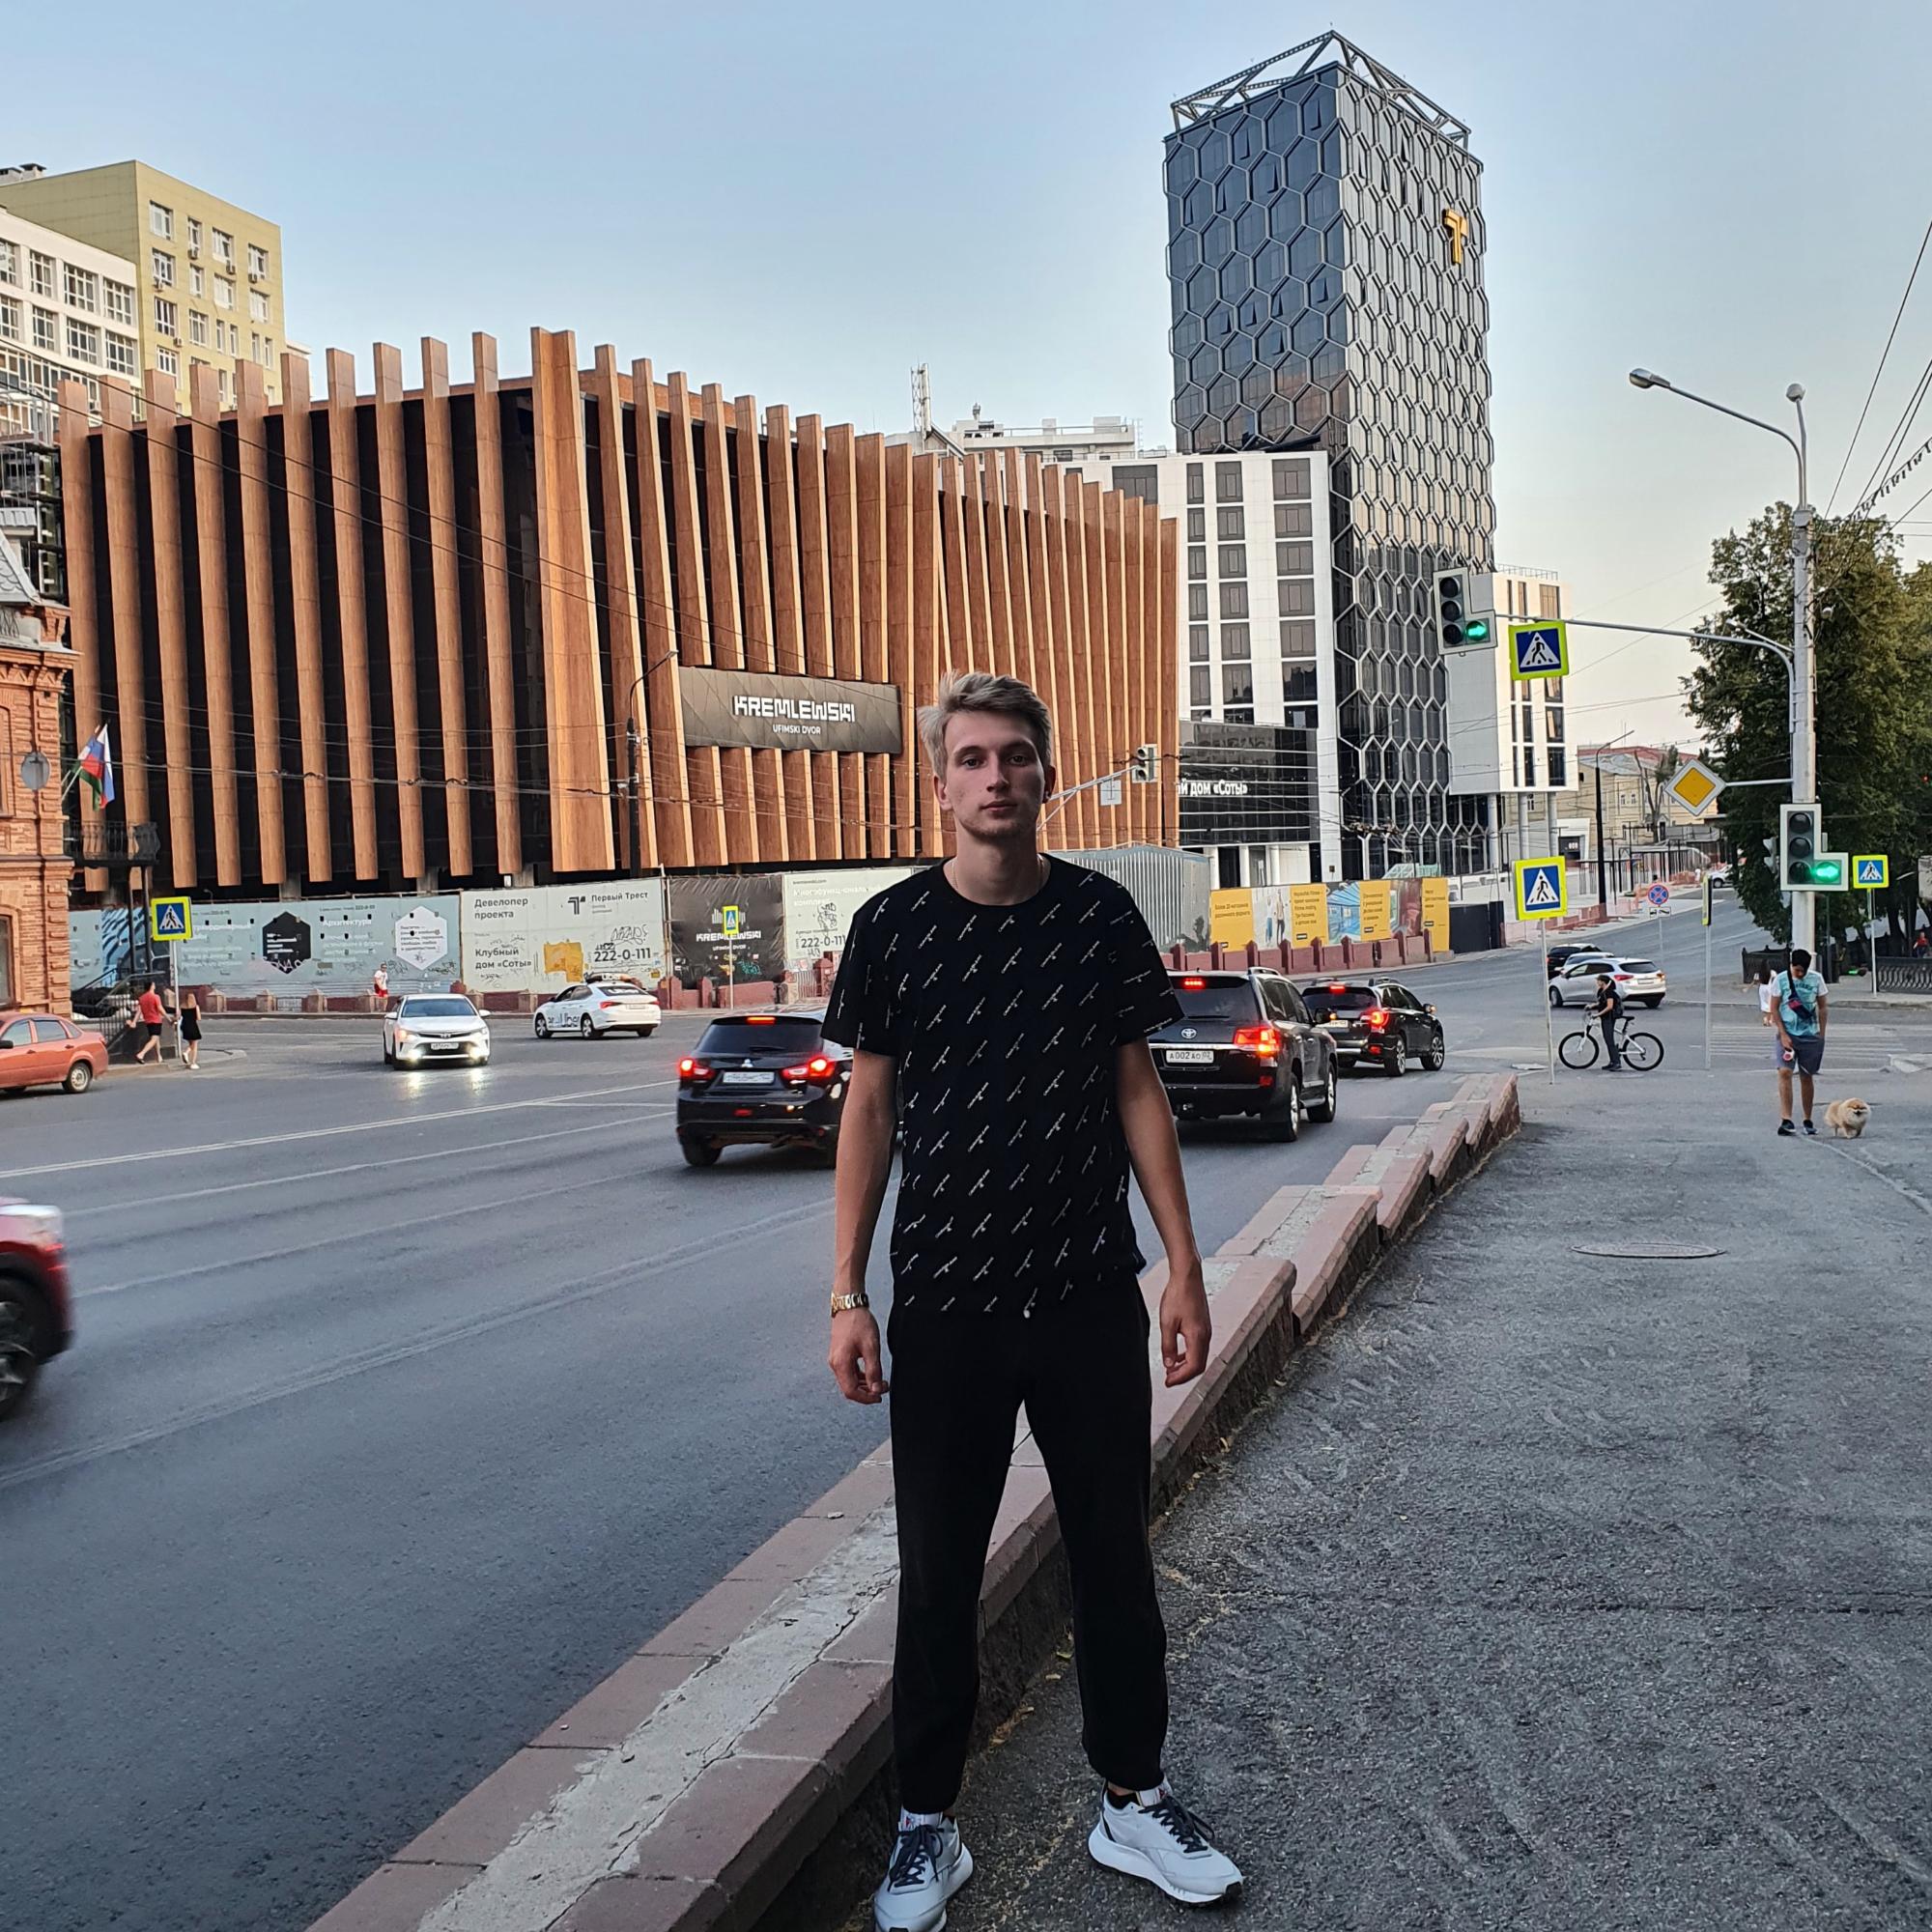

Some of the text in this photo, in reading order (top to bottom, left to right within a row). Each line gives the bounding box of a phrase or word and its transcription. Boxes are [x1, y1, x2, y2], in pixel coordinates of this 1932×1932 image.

[733, 696, 856, 723] KREMLEWSKI
[773, 724, 821, 734] UFIMSKI DVOR
[1212, 779, 1248, 795] «Соты»
[474, 897, 528, 908] Девелопер
[591, 892, 648, 902] Первый Трест
[474, 910, 514, 920] проекта
[474, 947, 520, 958] Клубный
[594, 947, 651, 962] 222-0-111
[475, 958, 532, 970] дом «Соты»
